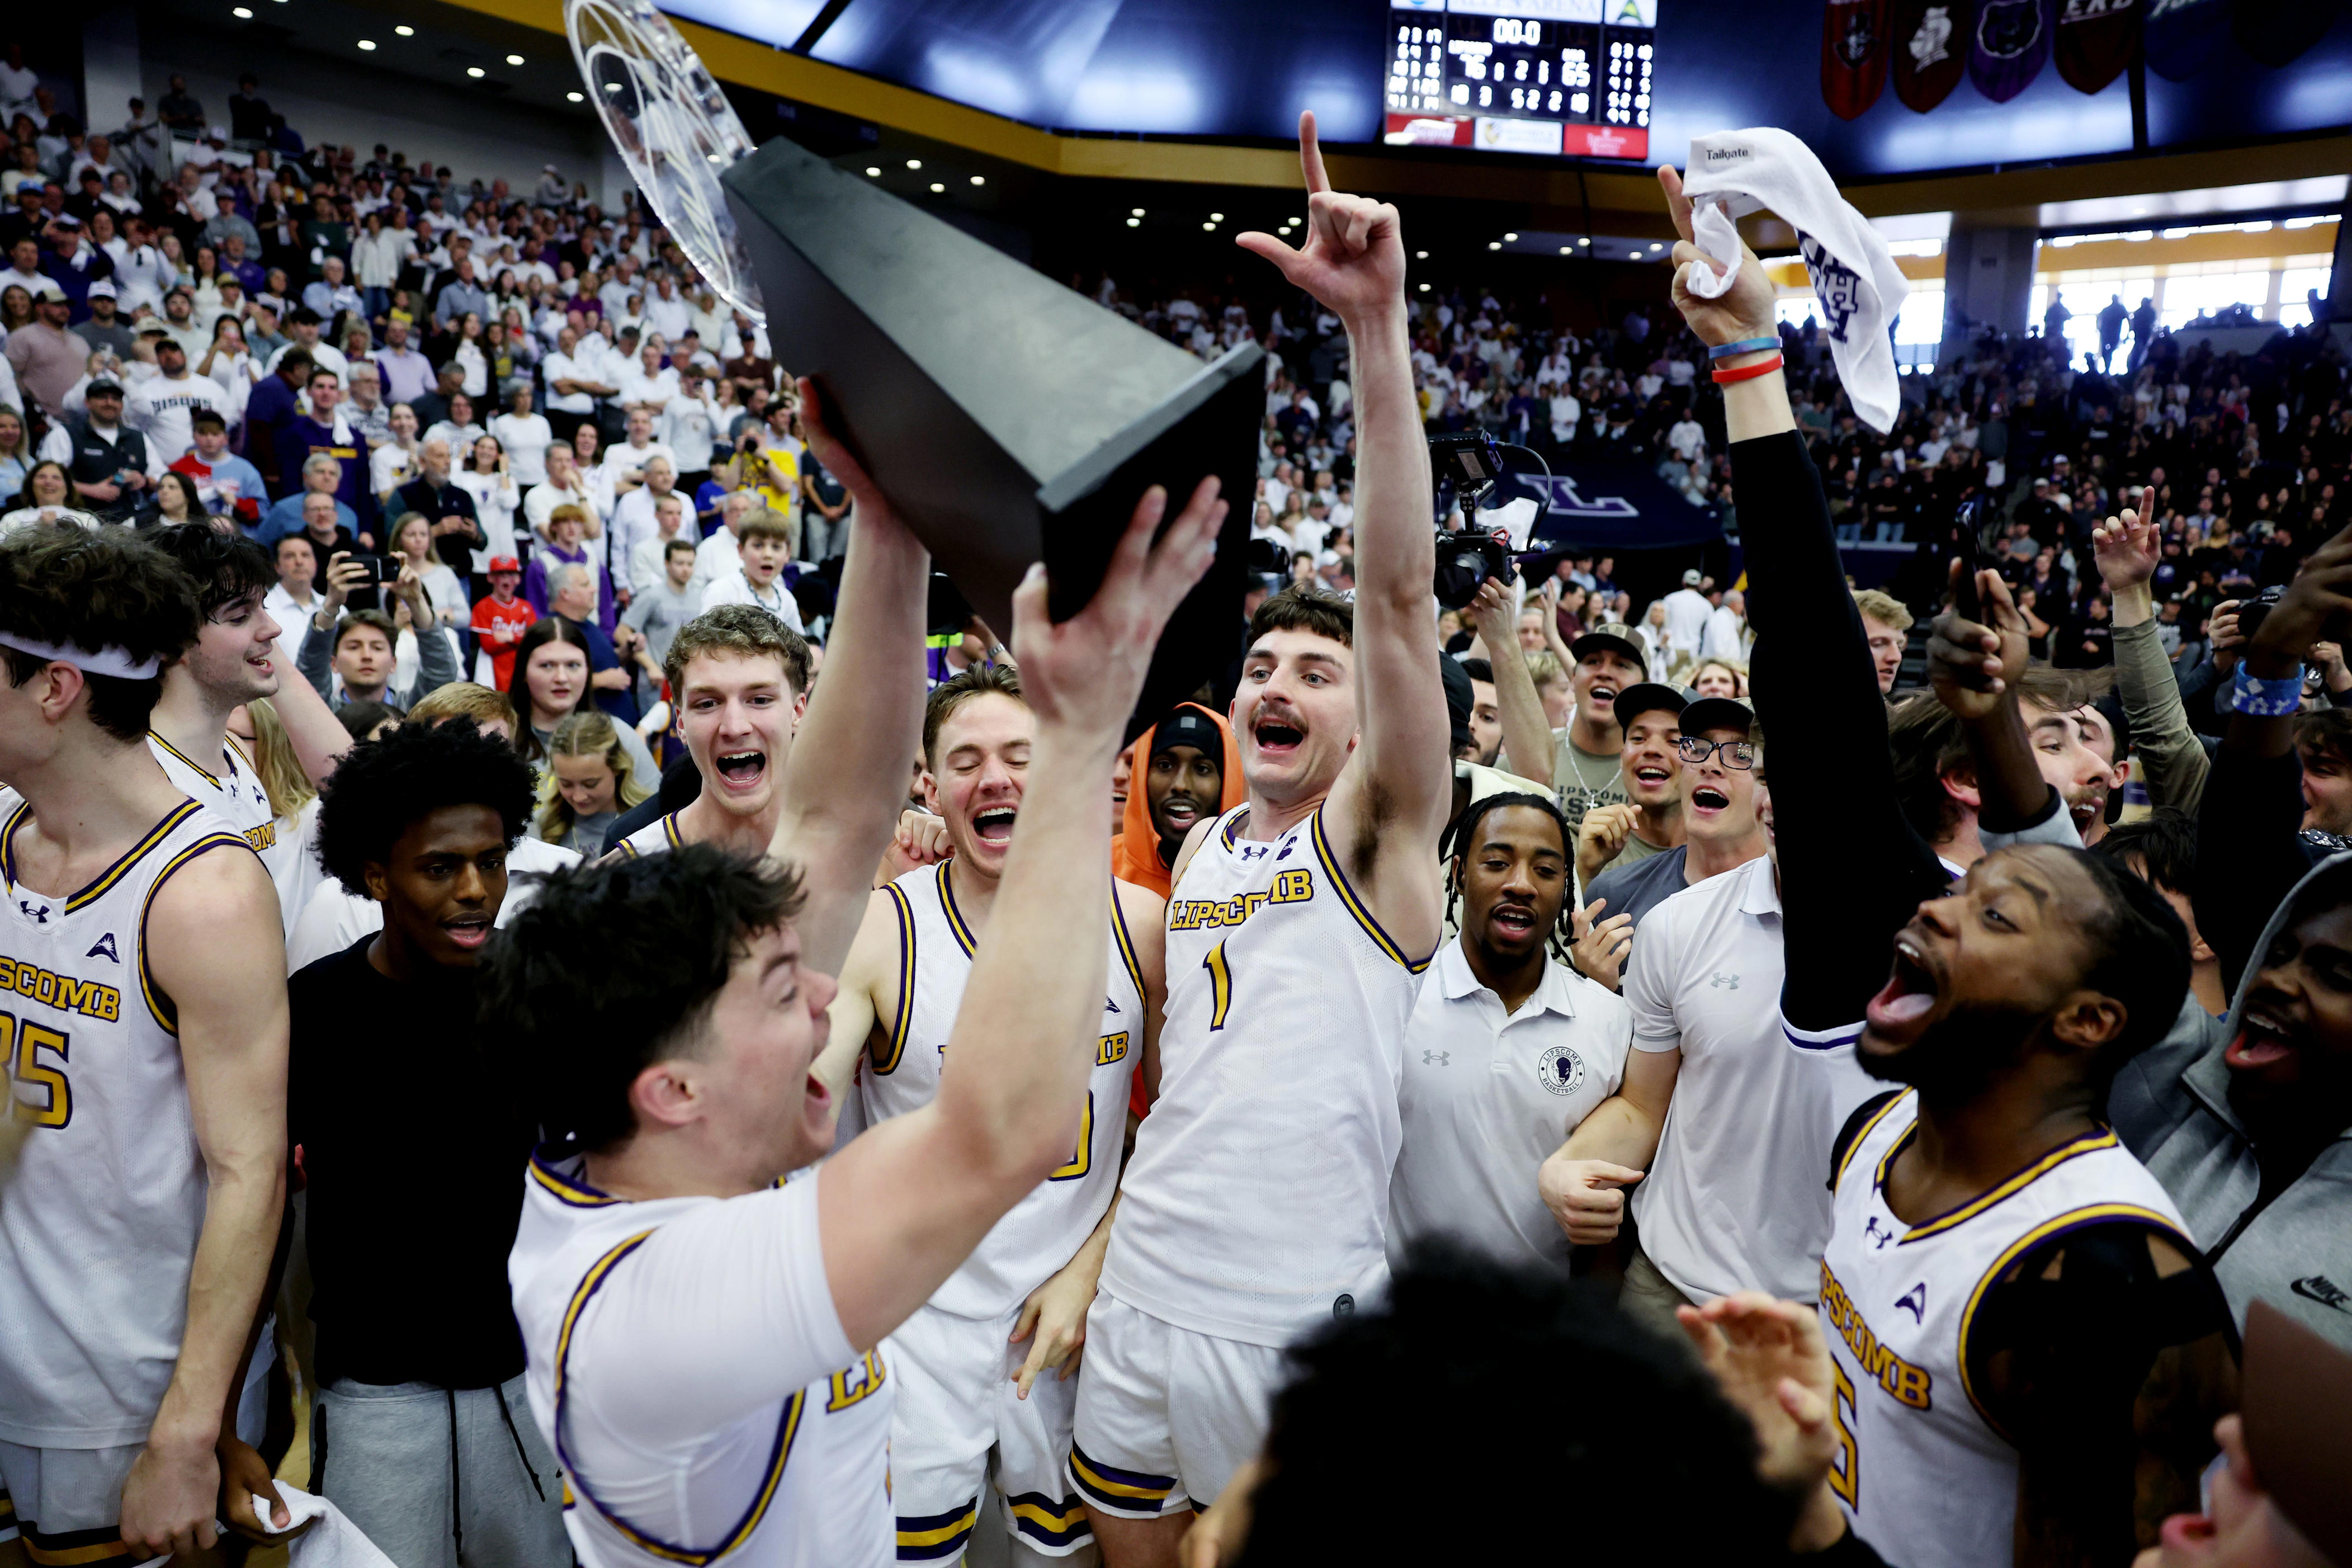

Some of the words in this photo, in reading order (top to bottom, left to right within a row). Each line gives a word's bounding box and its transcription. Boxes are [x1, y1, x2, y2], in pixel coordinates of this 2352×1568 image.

[1494, 18, 1541, 46] 00.0
[1514, 60, 1529, 81] 2
[1562, 62, 1590, 87] 65
[1548, 90, 1562, 112] 2
[1707, 148, 1748, 160] Tailgate
[1203, 938, 1232, 1031] 1
[1543, 1049, 1581, 1066] LIPSCOMB
[1542, 1078, 1580, 1093] BASKETBALL
[2306, 1276, 2351, 1304] NIKE
